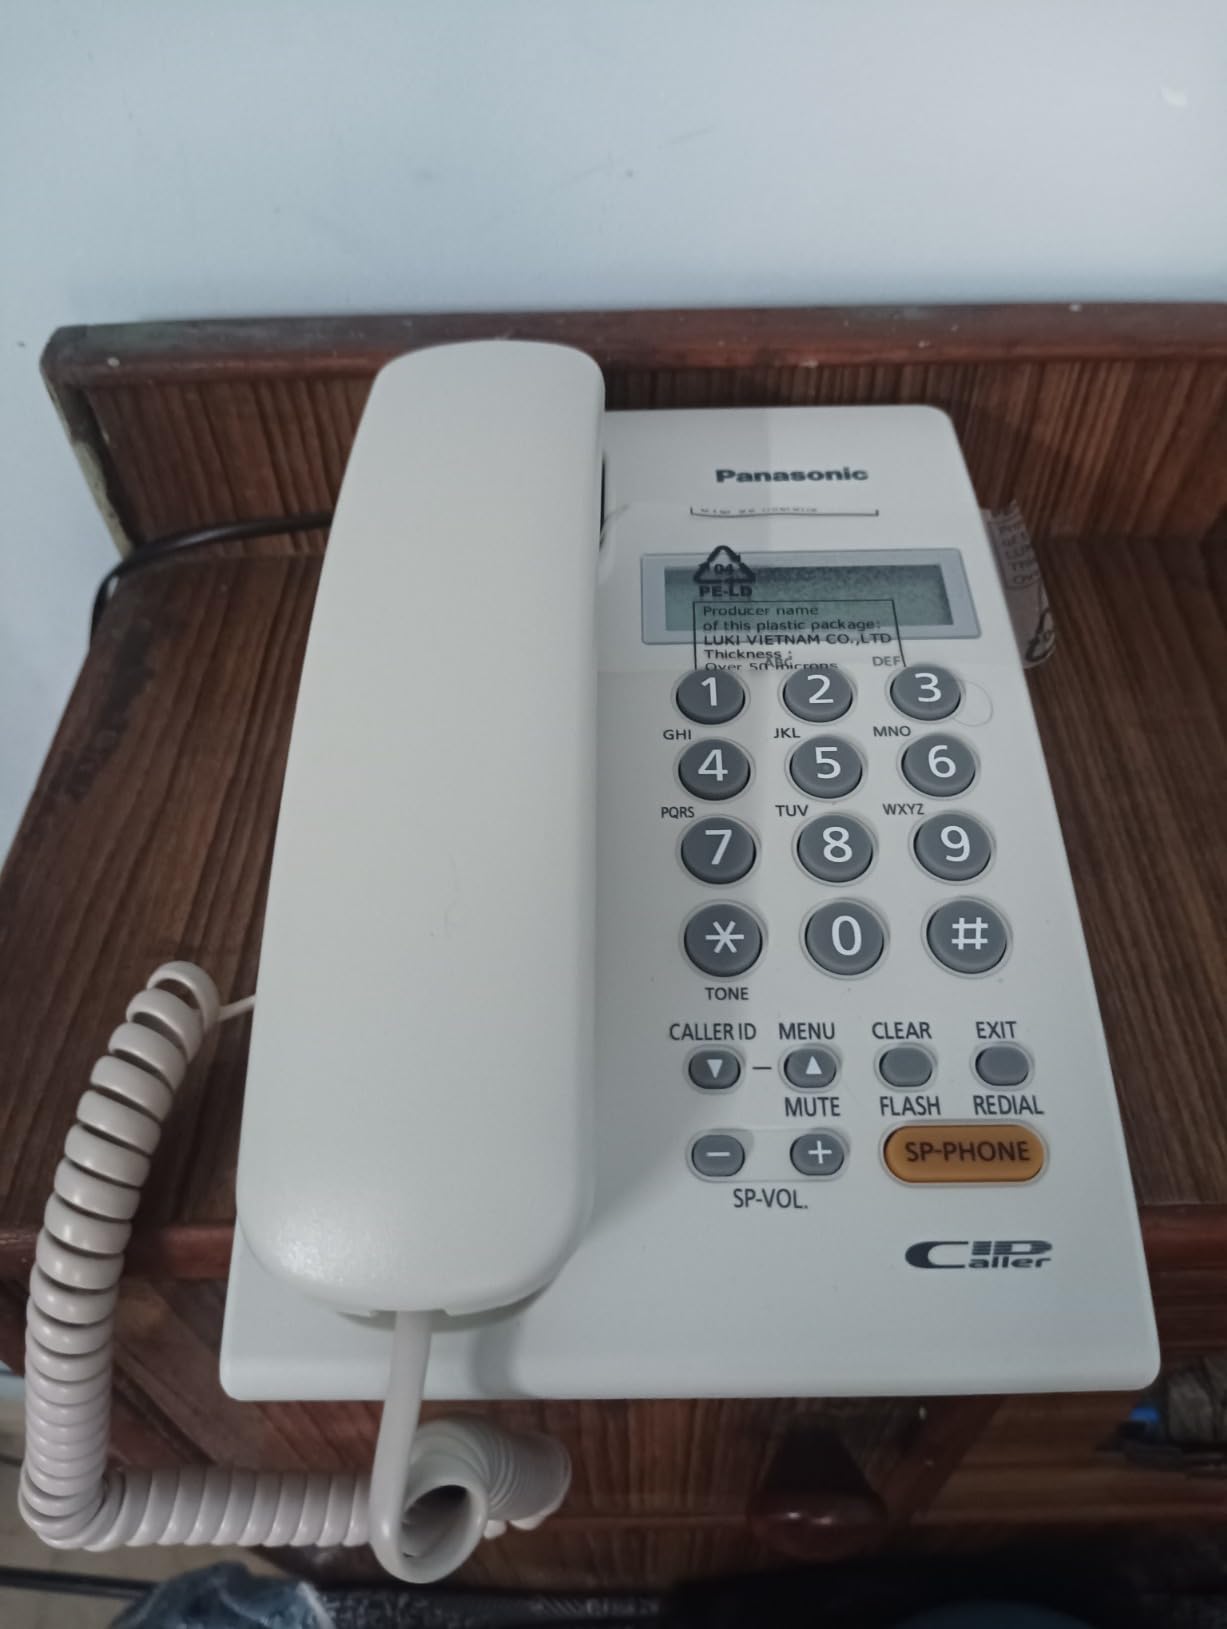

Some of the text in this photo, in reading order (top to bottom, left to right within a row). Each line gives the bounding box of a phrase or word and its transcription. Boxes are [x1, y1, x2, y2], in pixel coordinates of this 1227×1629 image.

[715, 467, 869, 483] Panasonic
[699, 585, 753, 598] PE-LD
[703, 605, 819, 617] Producer name
[703, 619, 881, 633] of this plastic package:
[703, 633, 892, 647] LUKI VIETNAM CO.,LTD
[703, 649, 782, 660] Thickness
[872, 655, 901, 667] DEF
[701, 676, 718, 706] 1
[807, 674, 835, 704] 2
[914, 672, 942, 702] 3
[663, 729, 692, 741] GHI
[773, 727, 801, 740] JKL
[873, 725, 911, 738] MNO
[698, 749, 728, 781] 4
[814, 746, 842, 779] 5
[928, 744, 957, 778] 6
[661, 806, 695, 820] PQRS
[775, 804, 809, 817] TUV
[883, 803, 925, 816] WXYZ
[704, 829, 733, 865] 7
[822, 826, 853, 863] 8
[940, 825, 971, 862] 9
[831, 915, 863, 956] 0
[705, 987, 749, 1001] TONE
[669, 1022, 757, 1041] CALLER ID
[778, 1022, 836, 1040] MENU
[872, 1021, 932, 1040] CLEAR
[975, 1020, 1017, 1039] EXIT
[784, 1096, 840, 1117] MUTE
[879, 1096, 941, 1117] FLASH
[973, 1095, 1044, 1116] REDIAL
[905, 1140, 1031, 1162] SP-PHONE
[733, 1187, 809, 1210] SP-VOL.
